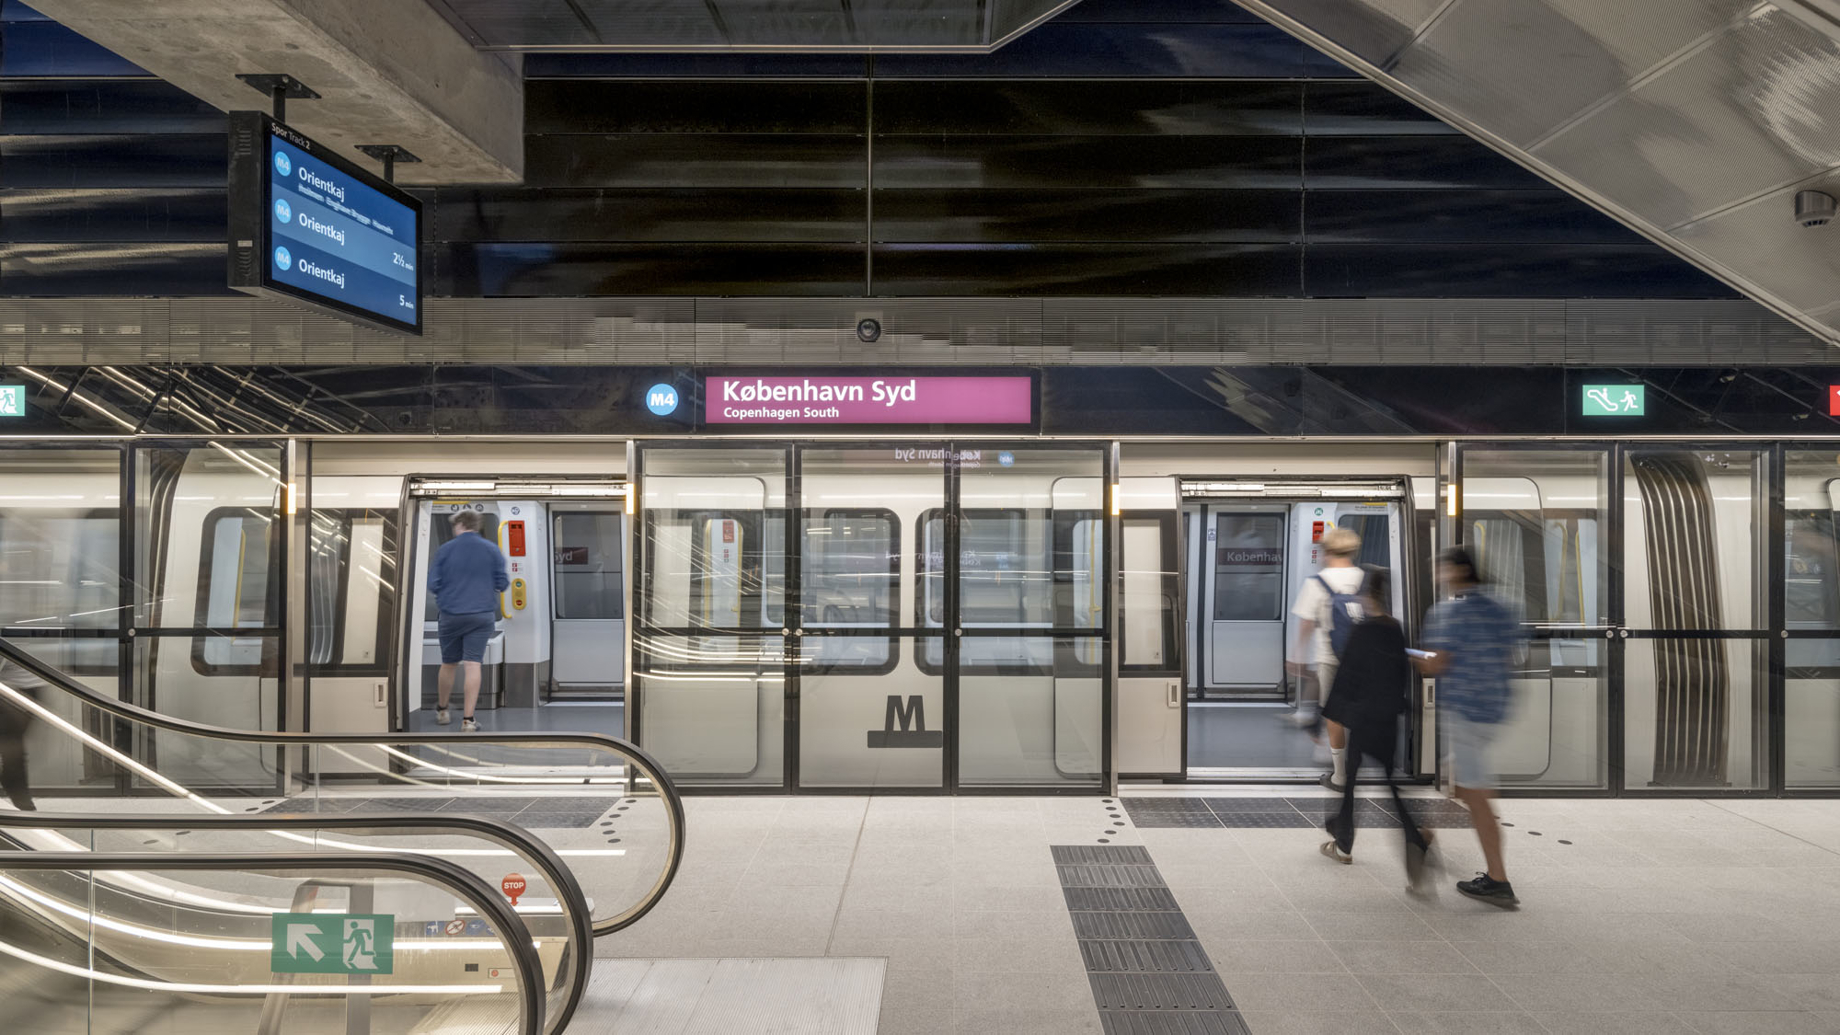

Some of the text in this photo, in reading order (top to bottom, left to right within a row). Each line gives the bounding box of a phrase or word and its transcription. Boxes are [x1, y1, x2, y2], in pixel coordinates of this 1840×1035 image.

[271, 122, 311, 150] Spor Track 2
[276, 156, 290, 171] M4
[298, 166, 345, 203] Orientkaj
[276, 203, 290, 218] M4
[298, 212, 345, 246] Orientkaj
[405, 262, 414, 272] min
[276, 250, 414, 310] M4 Orientkaj 5 min
[650, 393, 675, 407] M4
[723, 379, 916, 407] København Syd
[723, 406, 839, 420] Copenhagen South
[504, 881, 524, 889] STOP
